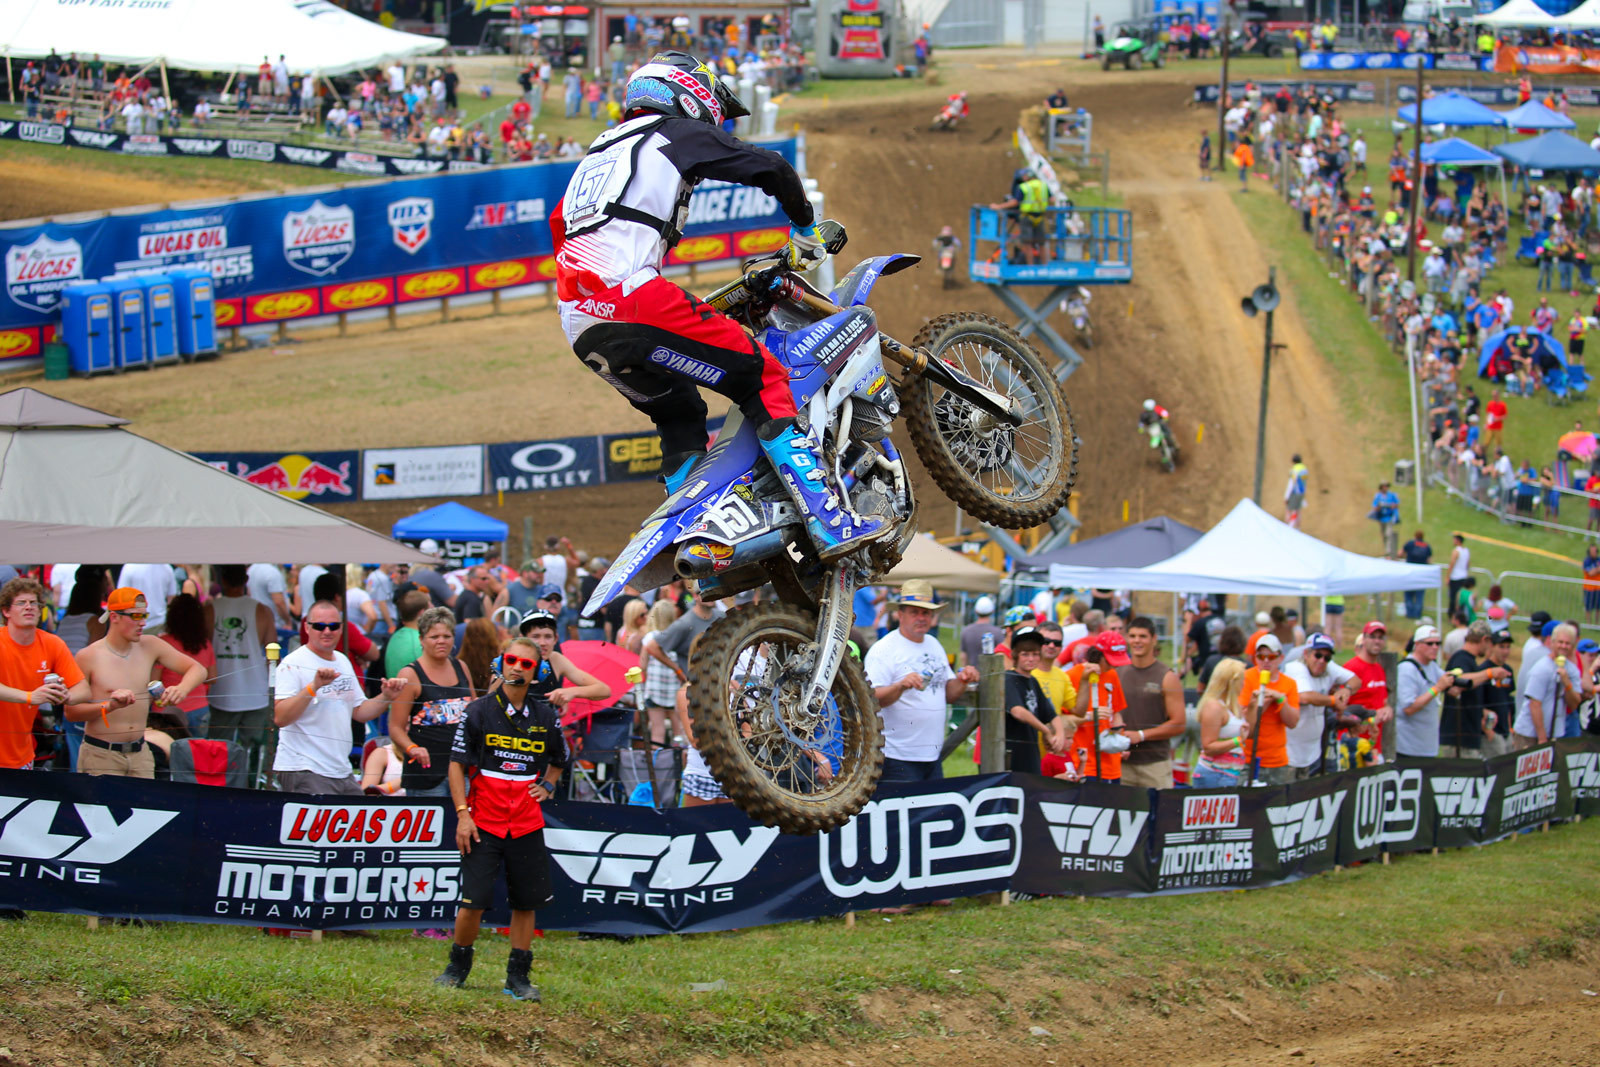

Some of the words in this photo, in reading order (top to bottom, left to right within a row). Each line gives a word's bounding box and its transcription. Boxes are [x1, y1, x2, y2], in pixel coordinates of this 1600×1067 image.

[682, 97, 698, 116] BELL
[729, 186, 777, 219] FANS
[144, 234, 194, 255] LUCAS
[198, 230, 222, 248] OIL
[294, 222, 349, 246] LUCAS
[17, 258, 76, 281] LUCAS
[30, 279, 72, 295] PRODUC
[579, 299, 616, 319] ANSR
[790, 321, 835, 358] YAMAHA
[666, 353, 722, 385] YAMAHA
[854, 362, 882, 392] GYTR
[610, 435, 663, 463] GEI
[496, 470, 594, 492] OAKLEY
[702, 493, 760, 540] 157
[617, 530, 664, 585] DUNLOP
[824, 644, 839, 681] GYTR
[485, 733, 545, 753] GEICO
[493, 749, 535, 762] HONDA
[1565, 752, 1600, 789] FL
[1354, 768, 1422, 849] WPS
[1430, 774, 1498, 816] FLY
[287, 807, 386, 843] LUCAS
[391, 809, 436, 842] OIL
[1185, 798, 1220, 826] LUCAS
[1219, 796, 1236, 824] OIL
[1266, 789, 1348, 850] FLY
[1440, 816, 1482, 829] RACING
[818, 785, 1025, 899] WPS
[1038, 801, 1150, 857] FLY
[1194, 829, 1221, 841] PRO
[325, 850, 395, 864] PRO
[543, 826, 780, 890] FLY
[1061, 856, 1124, 873] RACING
[1159, 841, 1253, 877] MOTOCROSS
[1277, 838, 1328, 864] RACING
[217, 861, 464, 903] MOTOCROS
[582, 886, 734, 908] RACING
[215, 900, 460, 920] CHAMPIONSHI
